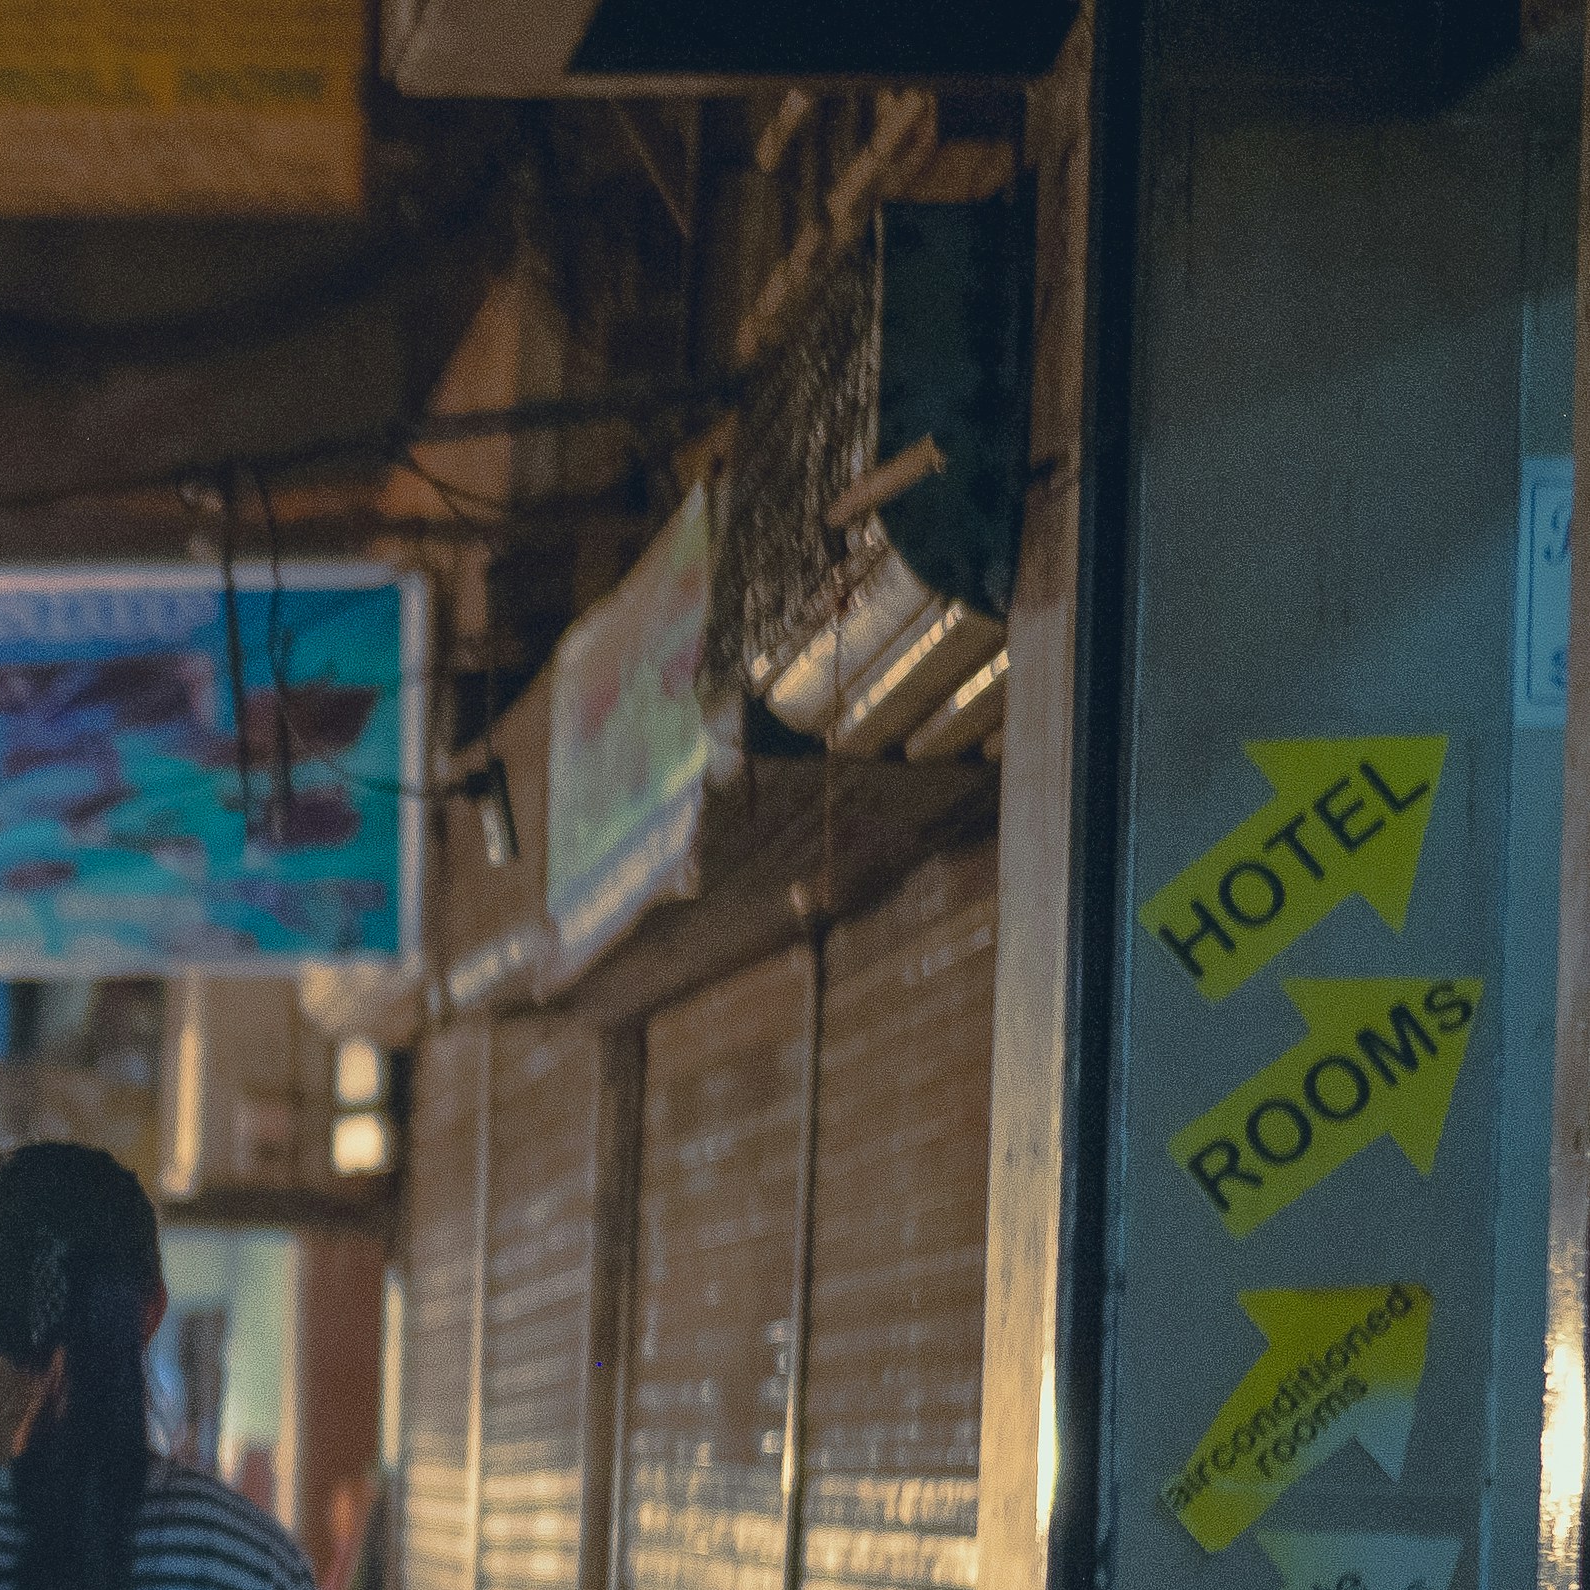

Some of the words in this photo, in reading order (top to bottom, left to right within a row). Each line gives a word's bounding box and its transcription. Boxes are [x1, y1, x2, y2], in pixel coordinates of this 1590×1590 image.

[1158, 761, 1430, 978] HOTEL
[1187, 980, 1474, 1213] ROOMS
[1166, 1283, 1413, 1511] airconditioned
[1255, 1375, 1368, 1478] rooms
